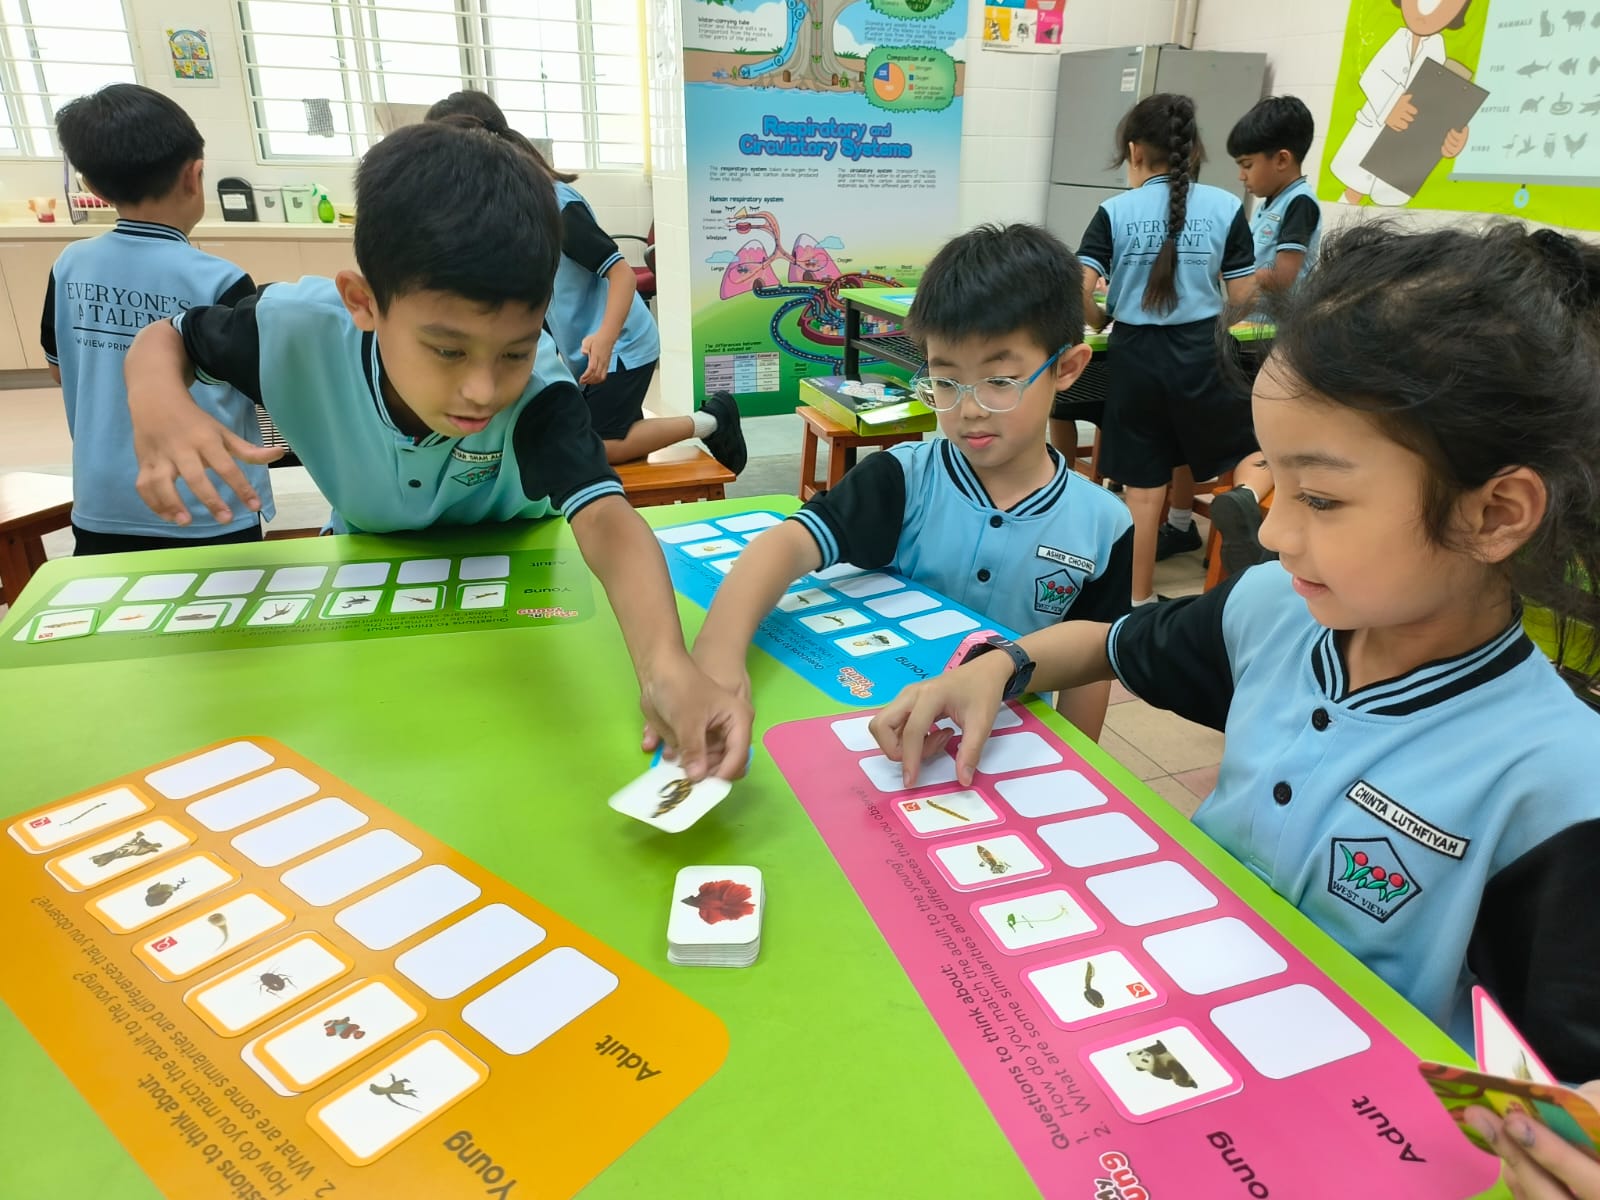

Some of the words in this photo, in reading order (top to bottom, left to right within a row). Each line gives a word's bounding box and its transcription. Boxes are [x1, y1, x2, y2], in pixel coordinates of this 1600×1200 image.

[762, 114, 867, 142] Respiratory
[869, 122, 892, 138] and
[739, 133, 838, 161] Circulatory
[840, 137, 912, 161] Systems
[730, 196, 762, 204] respiratory
[1126, 218, 1214, 236] EVERYNE'S
[1131, 236, 1142, 249] A
[66, 282, 191, 315] EVERYONE'S
[84, 339, 105, 348] VIEW
[1046, 549, 1066, 562] ASHER
[523, 585, 571, 595] Young
[895, 656, 930, 680] Young
[1354, 786, 1389, 816] CHINTA
[1391, 810, 1459, 854] LUTHFIYAH
[891, 839, 911, 859] that
[905, 858, 949, 911] differences
[913, 894, 931, 913] the
[1332, 881, 1360, 902] WEST
[1361, 896, 1388, 918] VIEW
[926, 912, 941, 926] to
[943, 911, 966, 934] and
[68, 928, 94, 947] you
[935, 926, 963, 957] adult
[81, 944, 107, 966] that
[958, 958, 978, 980] the
[961, 935, 1012, 999] similarities
[102, 961, 157, 1020] differences
[941, 963, 975, 1005] about:
[108, 1003, 131, 1024] the
[973, 980, 1009, 1023] match
[125, 1019, 141, 1036] to
[149, 1011, 176, 1033] and
[968, 1006, 1000, 1044] think
[1008, 1002, 1041, 1039] some
[139, 1031, 169, 1065] adult
[1003, 1025, 1031, 1053] you
[1037, 1040, 1060, 1066] are
[169, 1028, 230, 1091] similarities
[595, 1034, 662, 1082] Adult
[995, 1045, 1013, 1063] to
[1024, 1055, 1045, 1077] do
[161, 1055, 186, 1084] the
[180, 1076, 223, 1118] match
[223, 1086, 261, 1122] some
[1041, 1079, 1073, 1118] How
[1055, 1068, 1092, 1114] What
[1008, 1066, 1070, 1150] Questions
[170, 1108, 208, 1149] think
[216, 1115, 248, 1143] you
[255, 1117, 283, 1142] are
[1093, 1121, 1112, 1138] 2.
[1351, 1095, 1427, 1165] Adult
[202, 1143, 223, 1165] to
[239, 1140, 262, 1161] do
[273, 1138, 316, 1182] What
[255, 1160, 293, 1197] How
[443, 1130, 517, 1200] Young
[1206, 1130, 1269, 1200] oung
[315, 1178, 336, 1198] 2.
